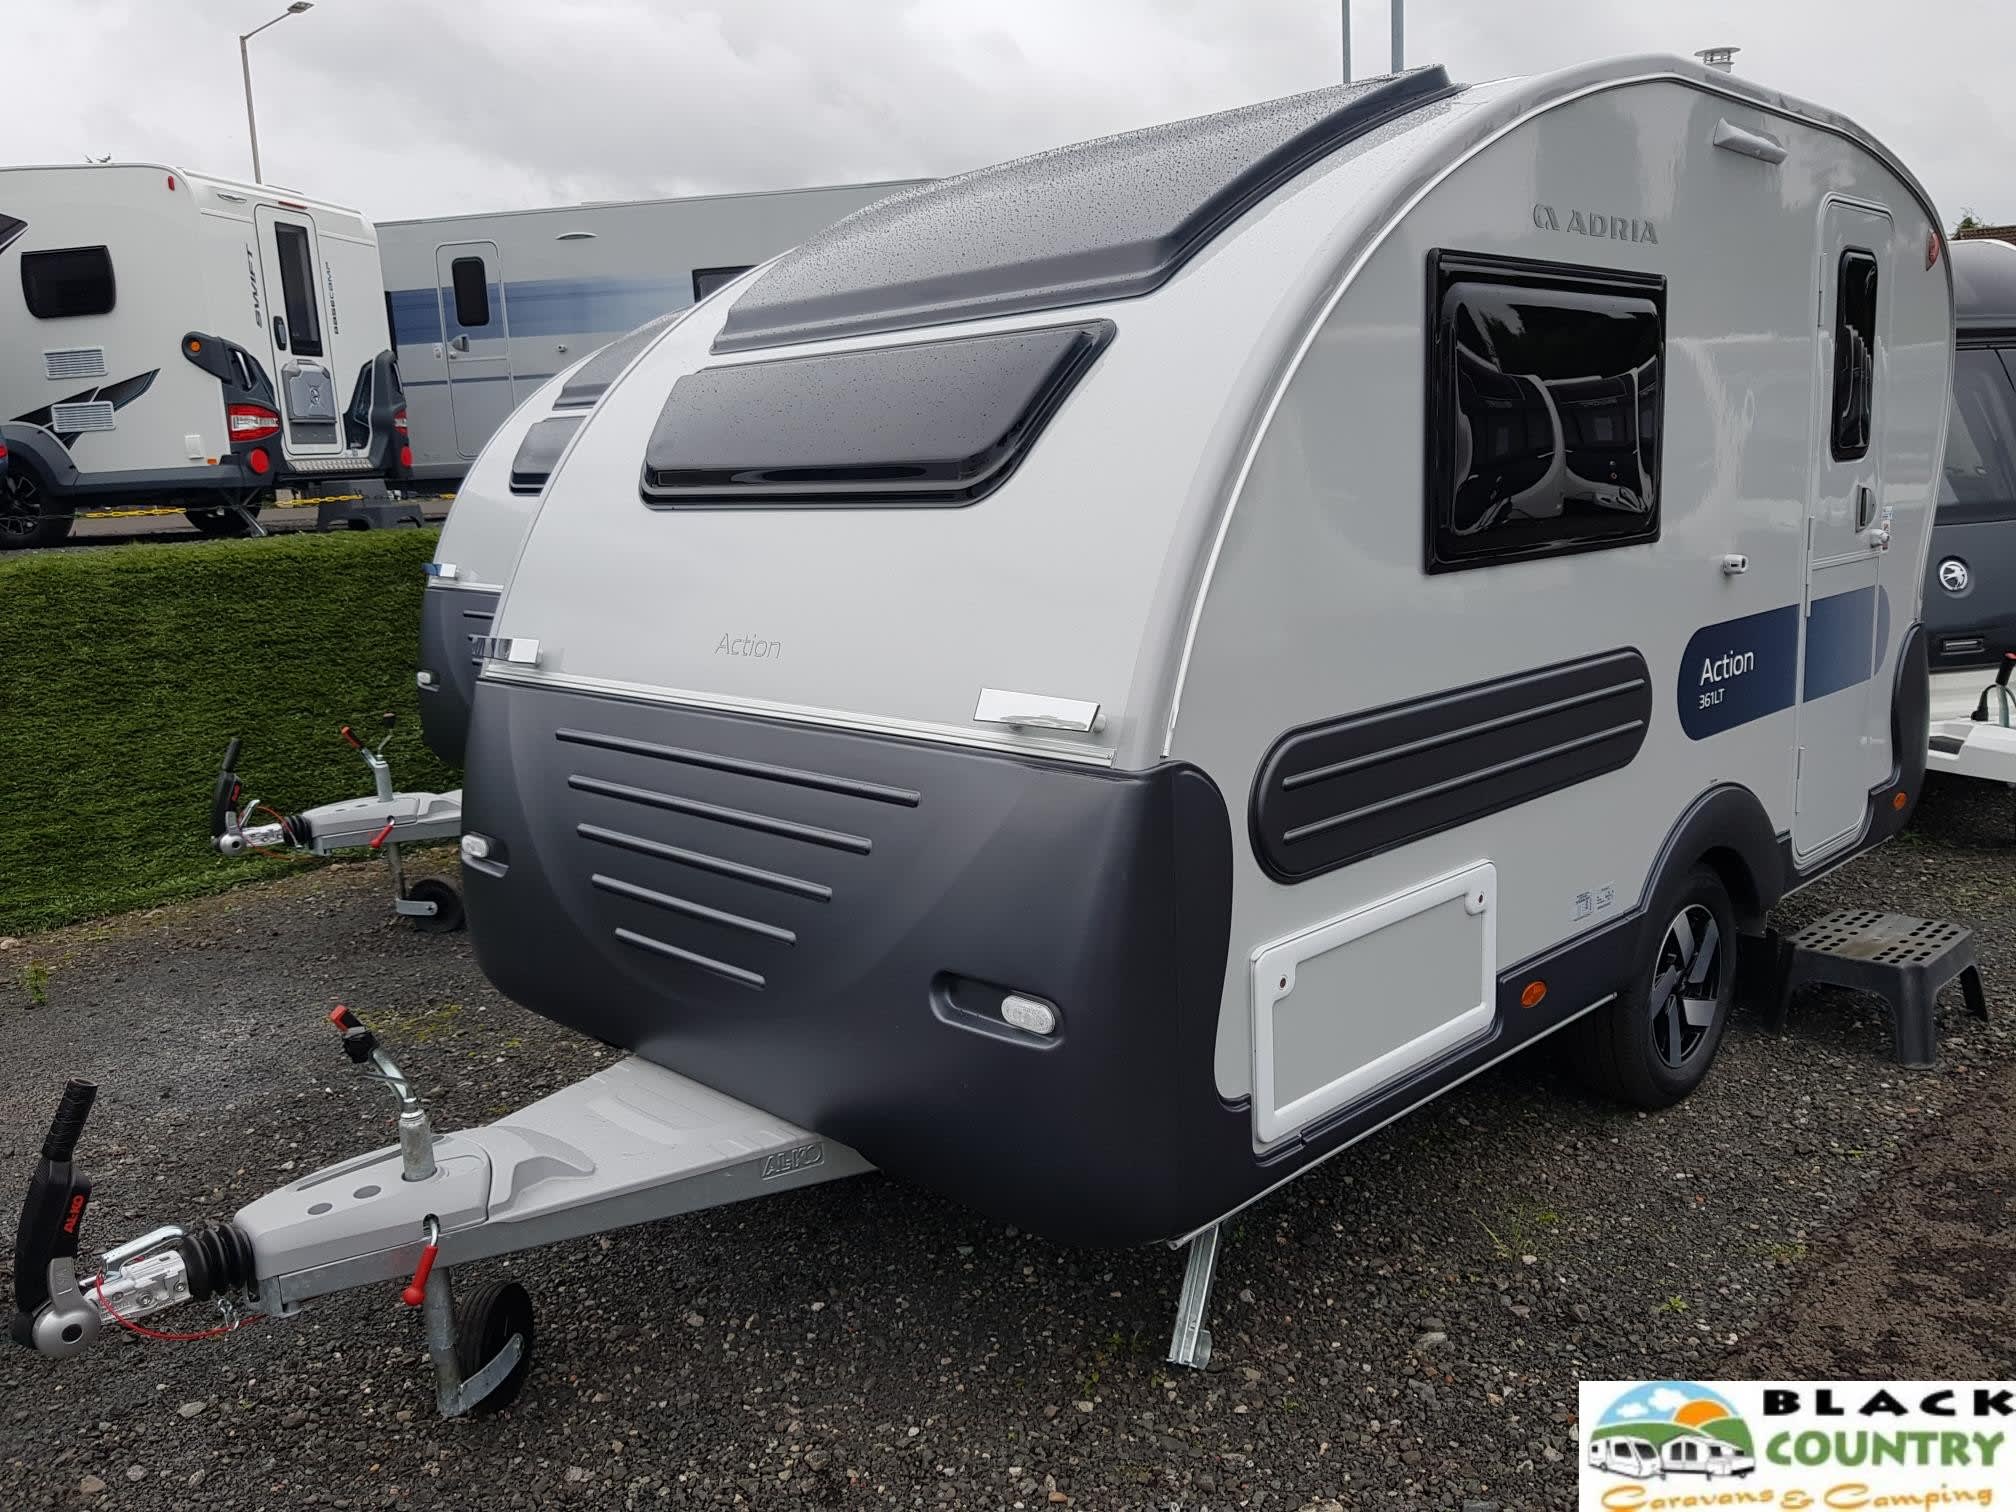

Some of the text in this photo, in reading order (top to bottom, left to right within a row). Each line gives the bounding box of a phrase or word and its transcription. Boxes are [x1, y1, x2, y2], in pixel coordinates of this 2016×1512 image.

[1566, 209, 1659, 245] ADRIA
[246, 242, 262, 328] SWIFT
[714, 632, 781, 659] Action
[1700, 650, 1754, 686] Action
[1699, 688, 1725, 710] 361LT
